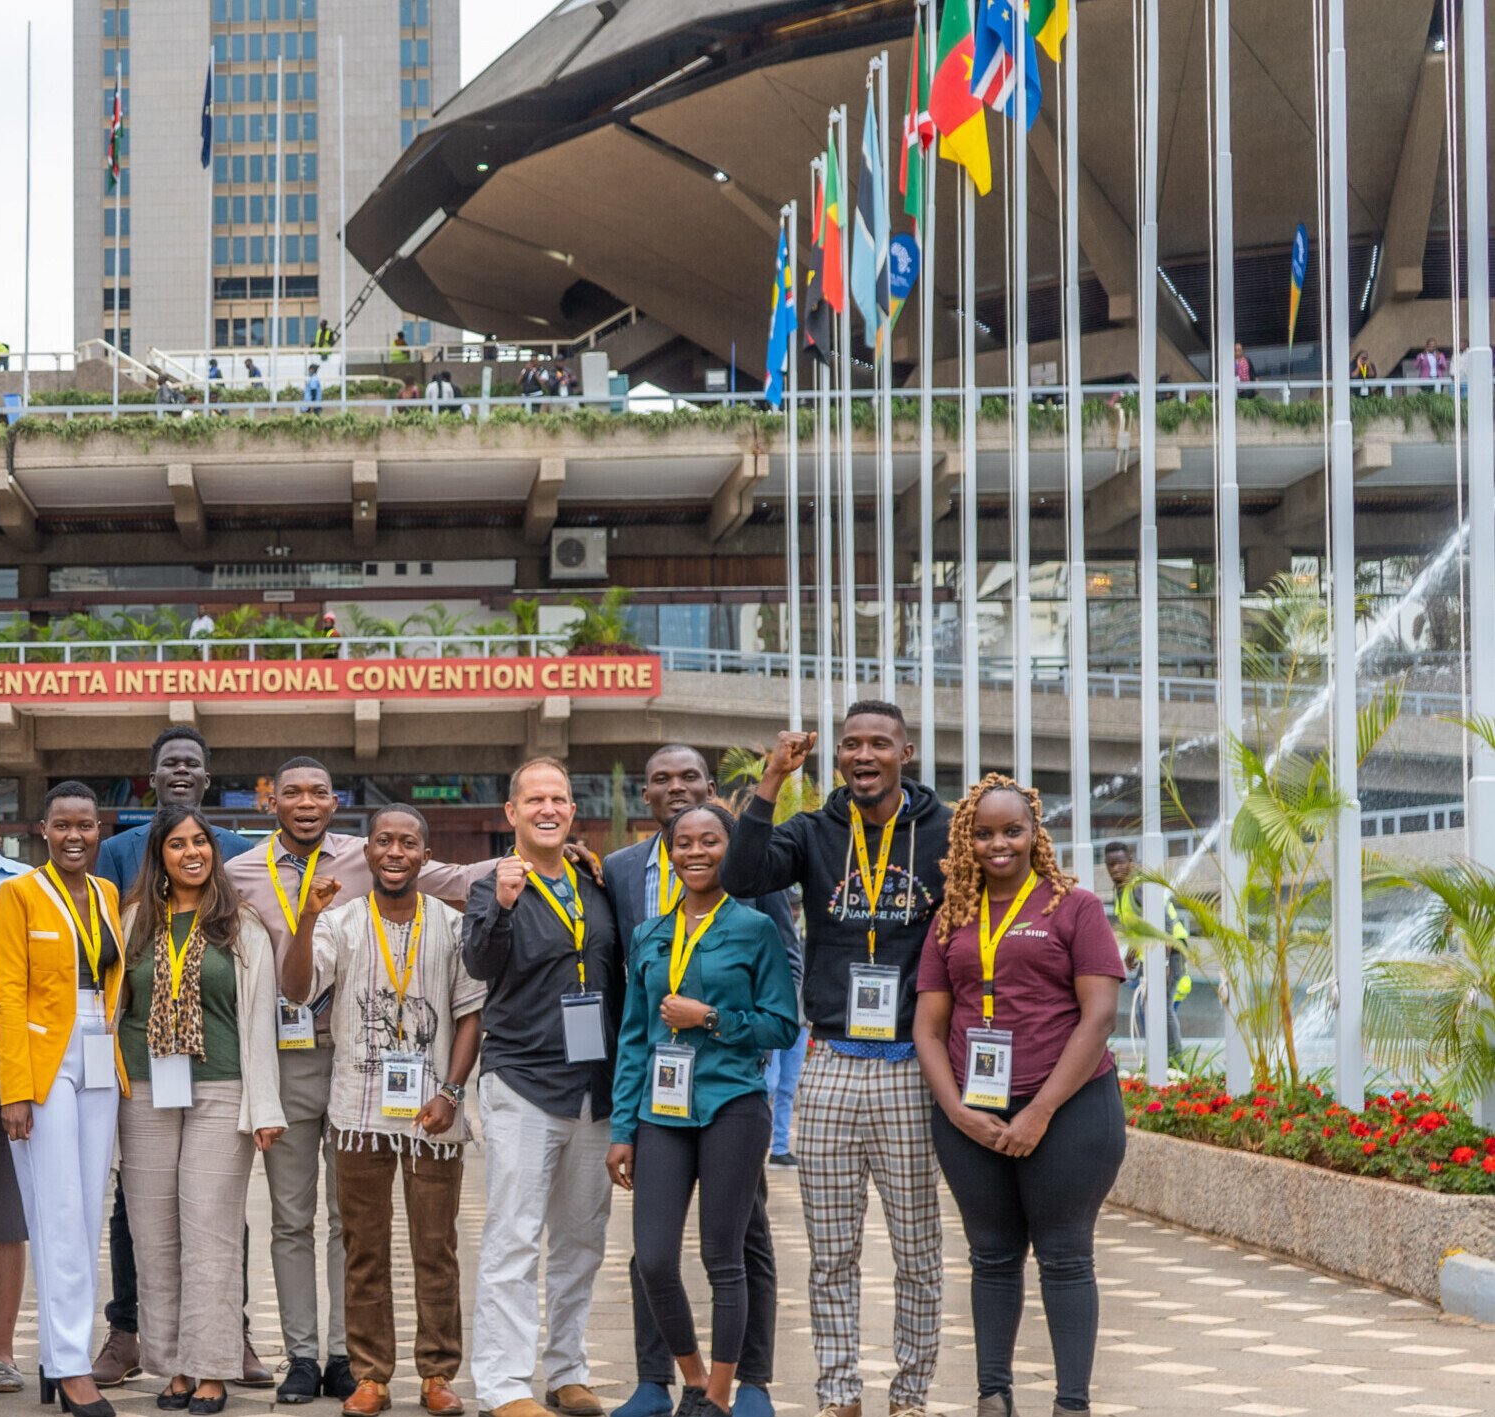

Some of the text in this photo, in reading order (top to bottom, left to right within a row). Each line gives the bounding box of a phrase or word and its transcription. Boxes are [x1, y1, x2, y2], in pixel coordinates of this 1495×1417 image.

[115, 666, 340, 694] INTERNATIONAL
[346, 664, 535, 692] CONVENTION
[541, 663, 653, 689] CENTRE
[834, 906, 887, 919] FNANCE
[1024, 929, 1049, 938] SHIP
